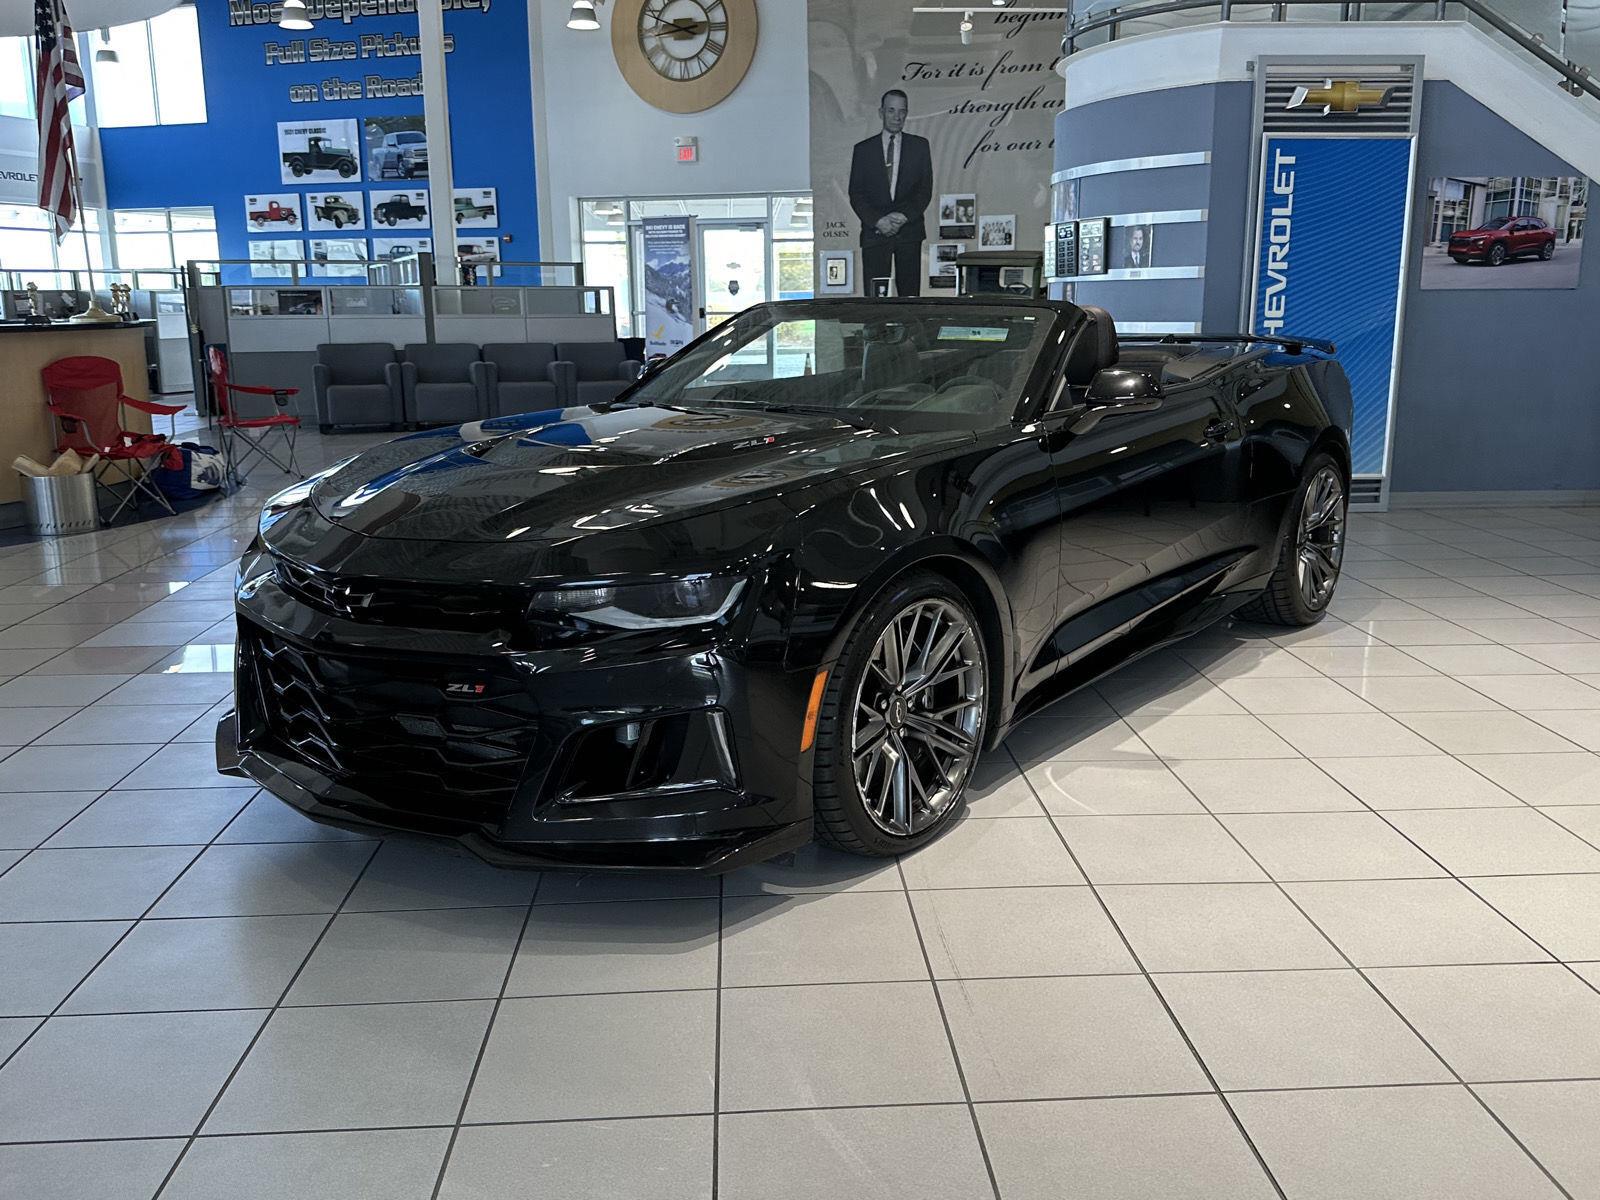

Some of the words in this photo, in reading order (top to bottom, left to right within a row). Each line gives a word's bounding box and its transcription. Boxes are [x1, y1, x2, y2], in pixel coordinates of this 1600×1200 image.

[229, 0, 284, 26] Mos
[306, 0, 490, 24] Depen,
[264, 40, 306, 66] Full
[308, 38, 357, 62] Size
[360, 32, 455, 58] Pickus
[902, 61, 945, 81] For
[948, 62, 967, 78] it
[968, 62, 986, 77] is
[981, 50, 1043, 91] from
[290, 84, 319, 103] on
[322, 77, 362, 101] the
[364, 72, 424, 99] Road
[949, 85, 1046, 128] strength
[963, 129, 1002, 169] for
[1006, 141, 1042, 152] our
[822, 230, 849, 238] OLSEN
[825, 221, 847, 230] JACK
[1263, 148, 1296, 336] HEVROLET
[446, 683, 485, 693] ZL1
